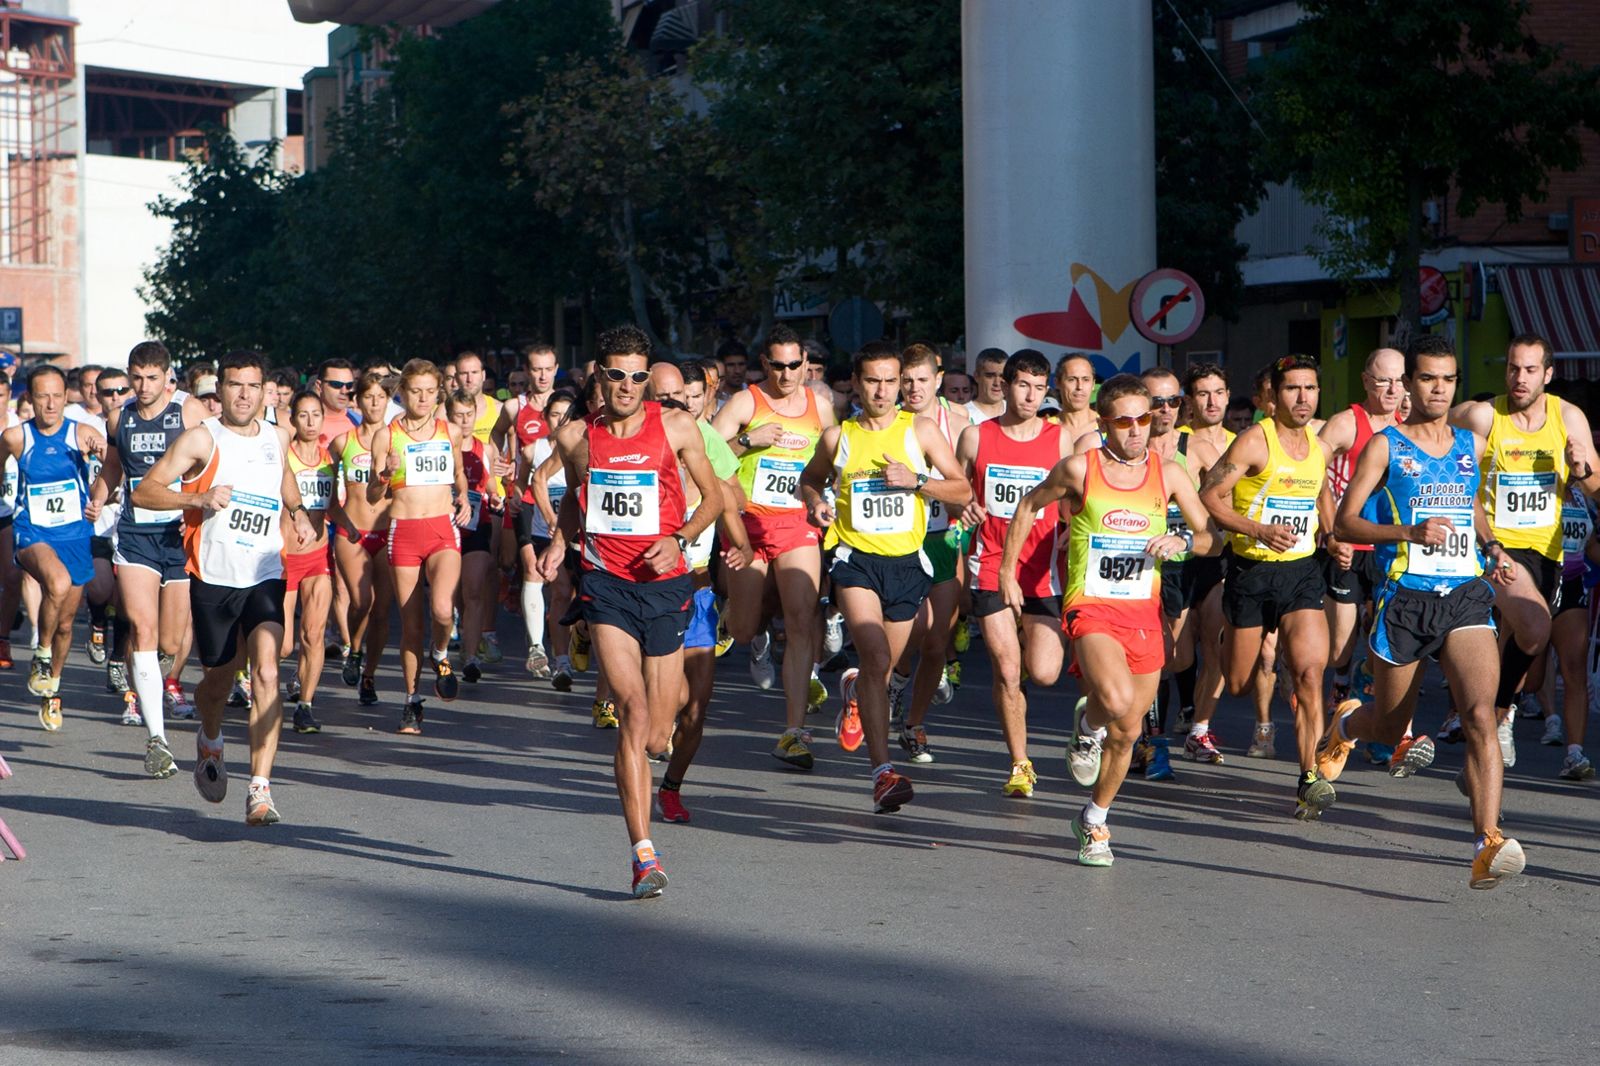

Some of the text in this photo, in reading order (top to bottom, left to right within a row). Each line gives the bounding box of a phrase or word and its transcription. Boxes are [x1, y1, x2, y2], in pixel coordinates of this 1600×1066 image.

[4, 311, 16, 331] P
[415, 455, 447, 473] 9518
[301, 480, 332, 498] 9409
[765, 473, 797, 495] 268
[1421, 484, 1465, 495] LA POBLA
[46, 497, 65, 513] 42
[601, 491, 643, 517] 463
[862, 496, 904, 519] 9168
[1409, 497, 1424, 507] DE
[1507, 491, 1547, 512] 9145
[228, 508, 271, 537] 9591
[1106, 514, 1147, 528] Serrano
[1099, 555, 1146, 581] 9527
